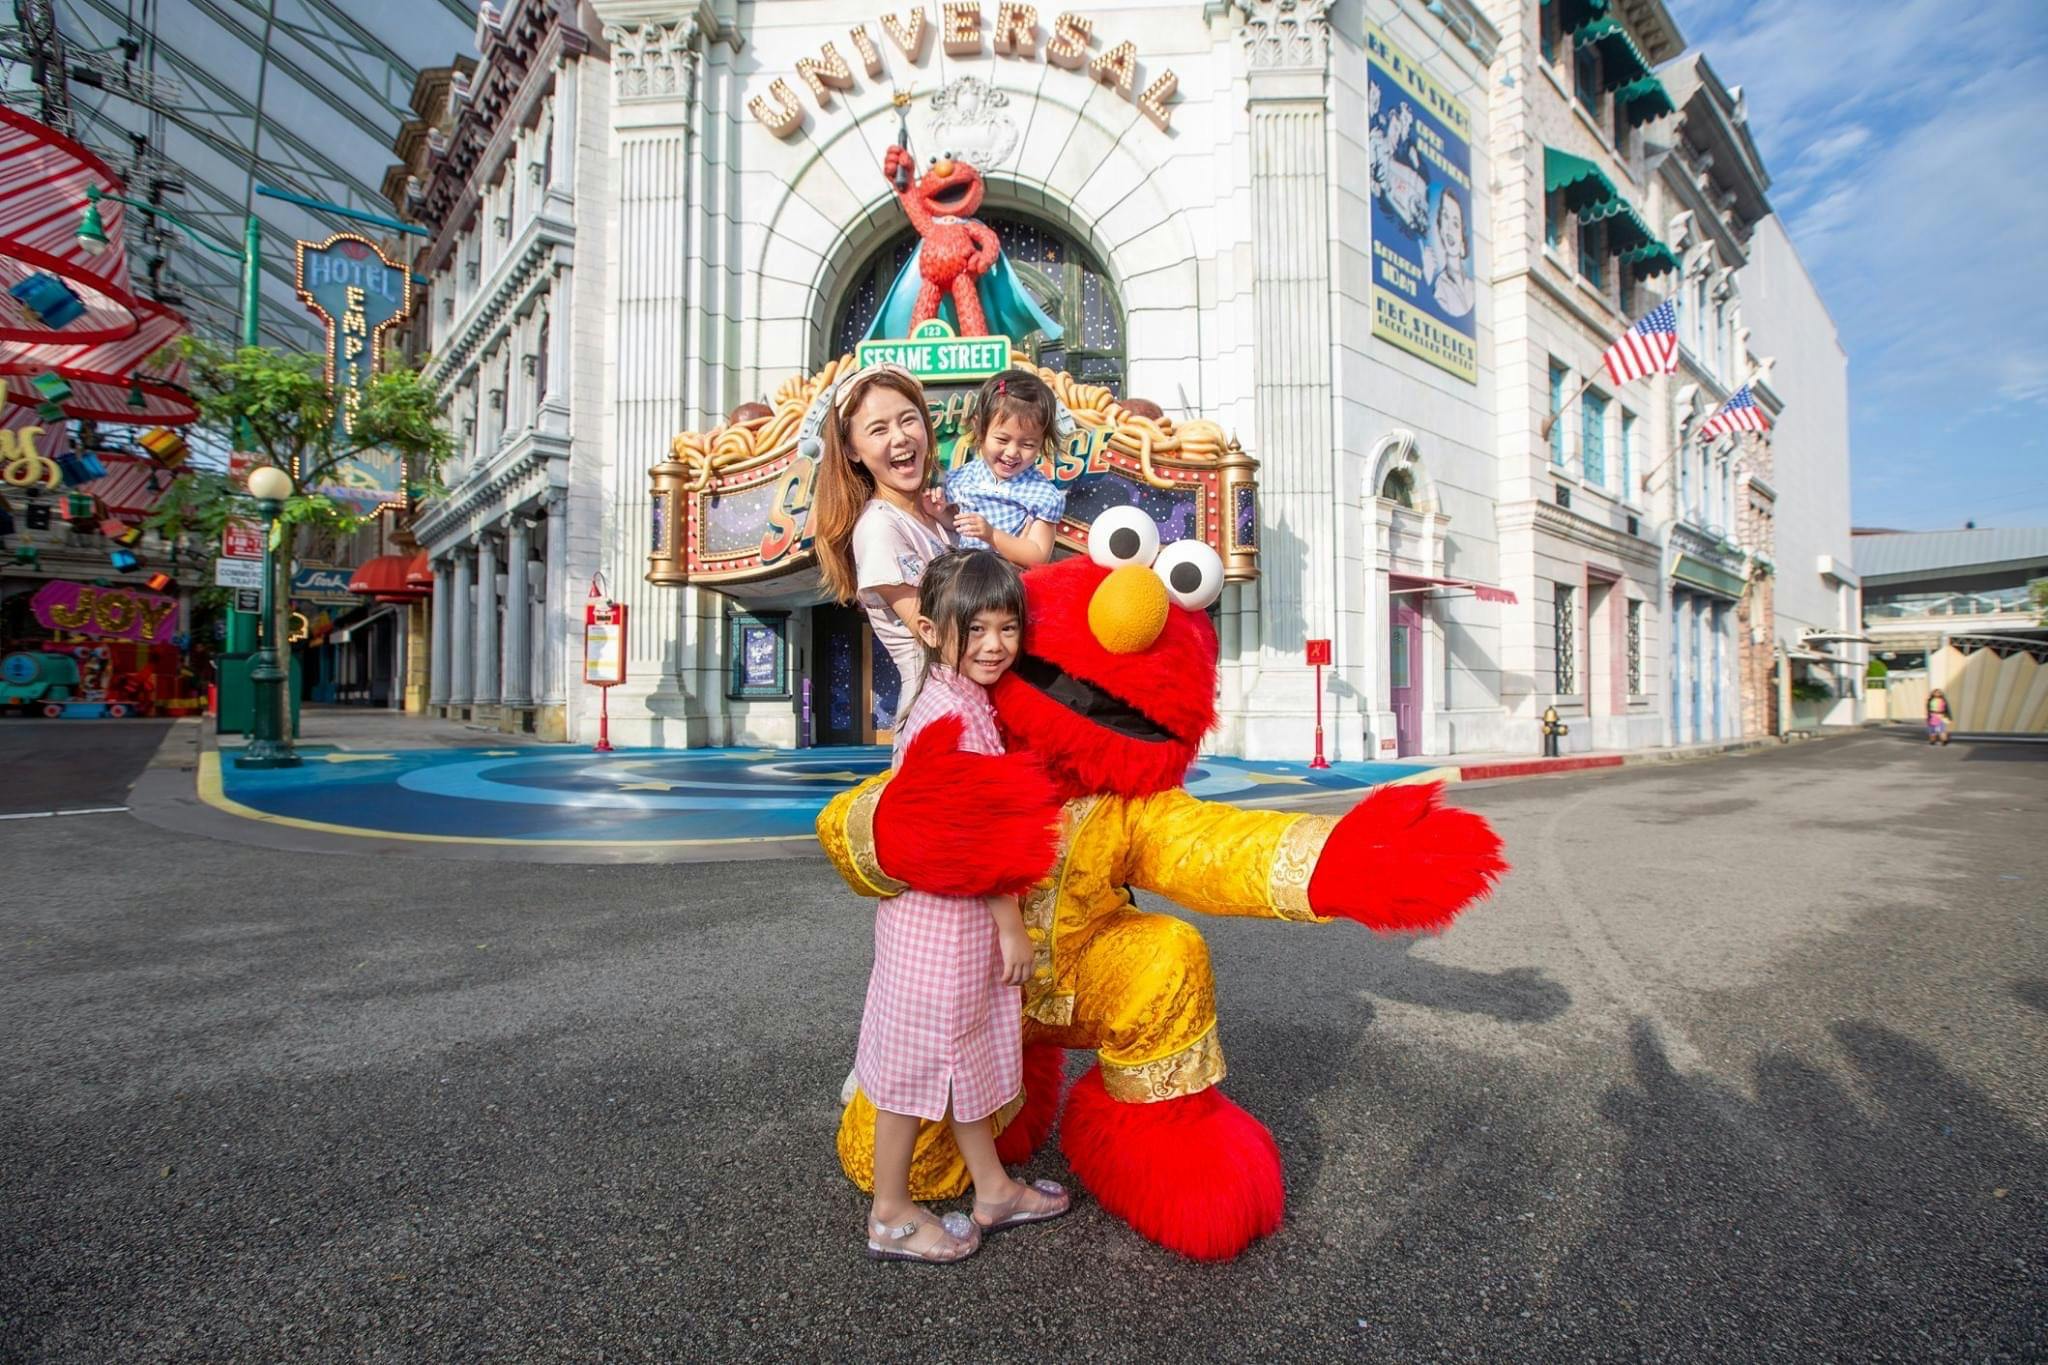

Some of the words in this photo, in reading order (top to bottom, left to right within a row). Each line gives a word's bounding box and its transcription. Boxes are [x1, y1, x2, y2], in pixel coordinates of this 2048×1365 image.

[747, 2, 1178, 138] UNIVERSAL
[1368, 32, 1386, 58] BE
[1392, 55, 1402, 72] A
[1407, 67, 1425, 94] TV
[310, 252, 396, 303] HOTEL
[923, 326, 941, 337] 123
[1376, 297, 1407, 326] NBC
[1413, 317, 1474, 361] STUDIOS
[937, 343, 1004, 372] STREET
[50, 588, 178, 639] JOY
